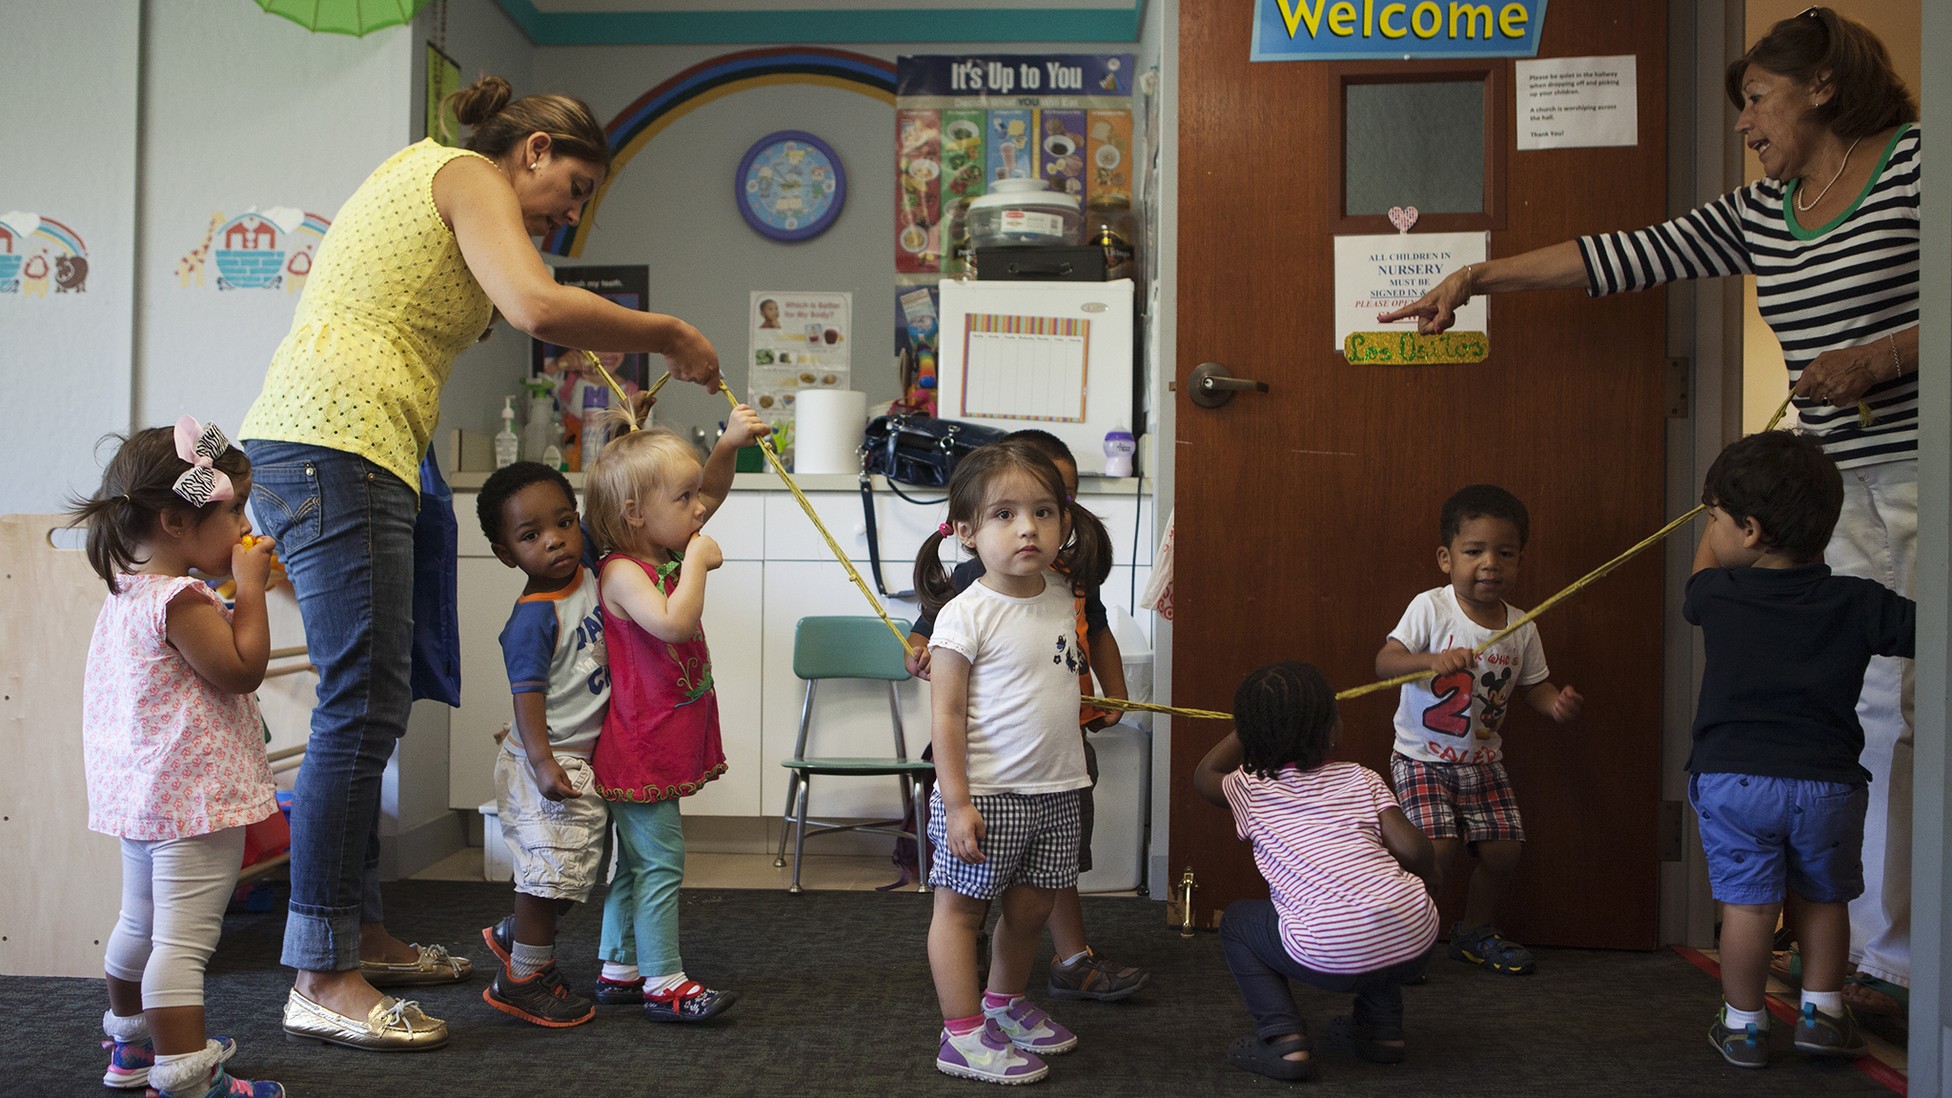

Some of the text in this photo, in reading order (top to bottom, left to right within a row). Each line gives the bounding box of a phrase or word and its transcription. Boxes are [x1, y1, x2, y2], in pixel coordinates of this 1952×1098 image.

[1274, 0, 1529, 39] Welcome
[951, 62, 1083, 93] It's Up to You
[1018, 97, 1039, 106] YOU
[1389, 252, 1438, 261] CHILDREN
[1378, 264, 1444, 276] NURSERY
[1418, 278, 1431, 286] BE
[1370, 289, 1405, 297] SIGNED
[1355, 300, 1389, 308] PLEASE
[1349, 334, 1392, 361] Los
[1422, 669, 1475, 738] 2
